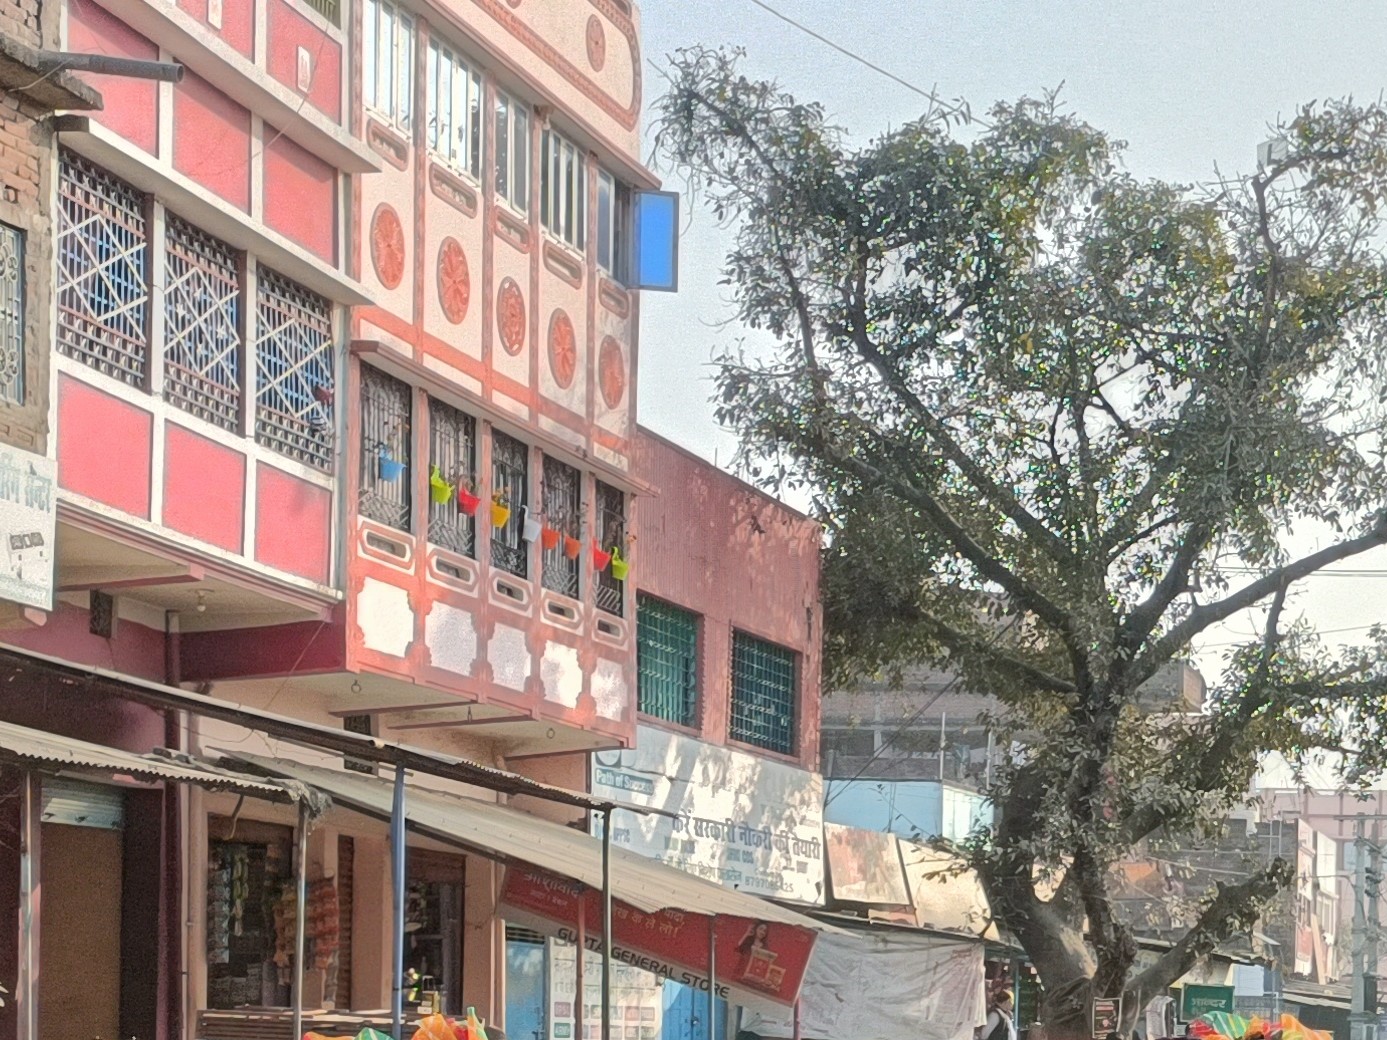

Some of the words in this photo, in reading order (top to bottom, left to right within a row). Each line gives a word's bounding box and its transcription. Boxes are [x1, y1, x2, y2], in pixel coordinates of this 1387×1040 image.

[596, 768, 615, 786] Path
[615, 774, 624, 788] of
[692, 817, 736, 843] सरकारी
[611, 946, 678, 979] GENERAL
[681, 972, 730, 999] STORE
